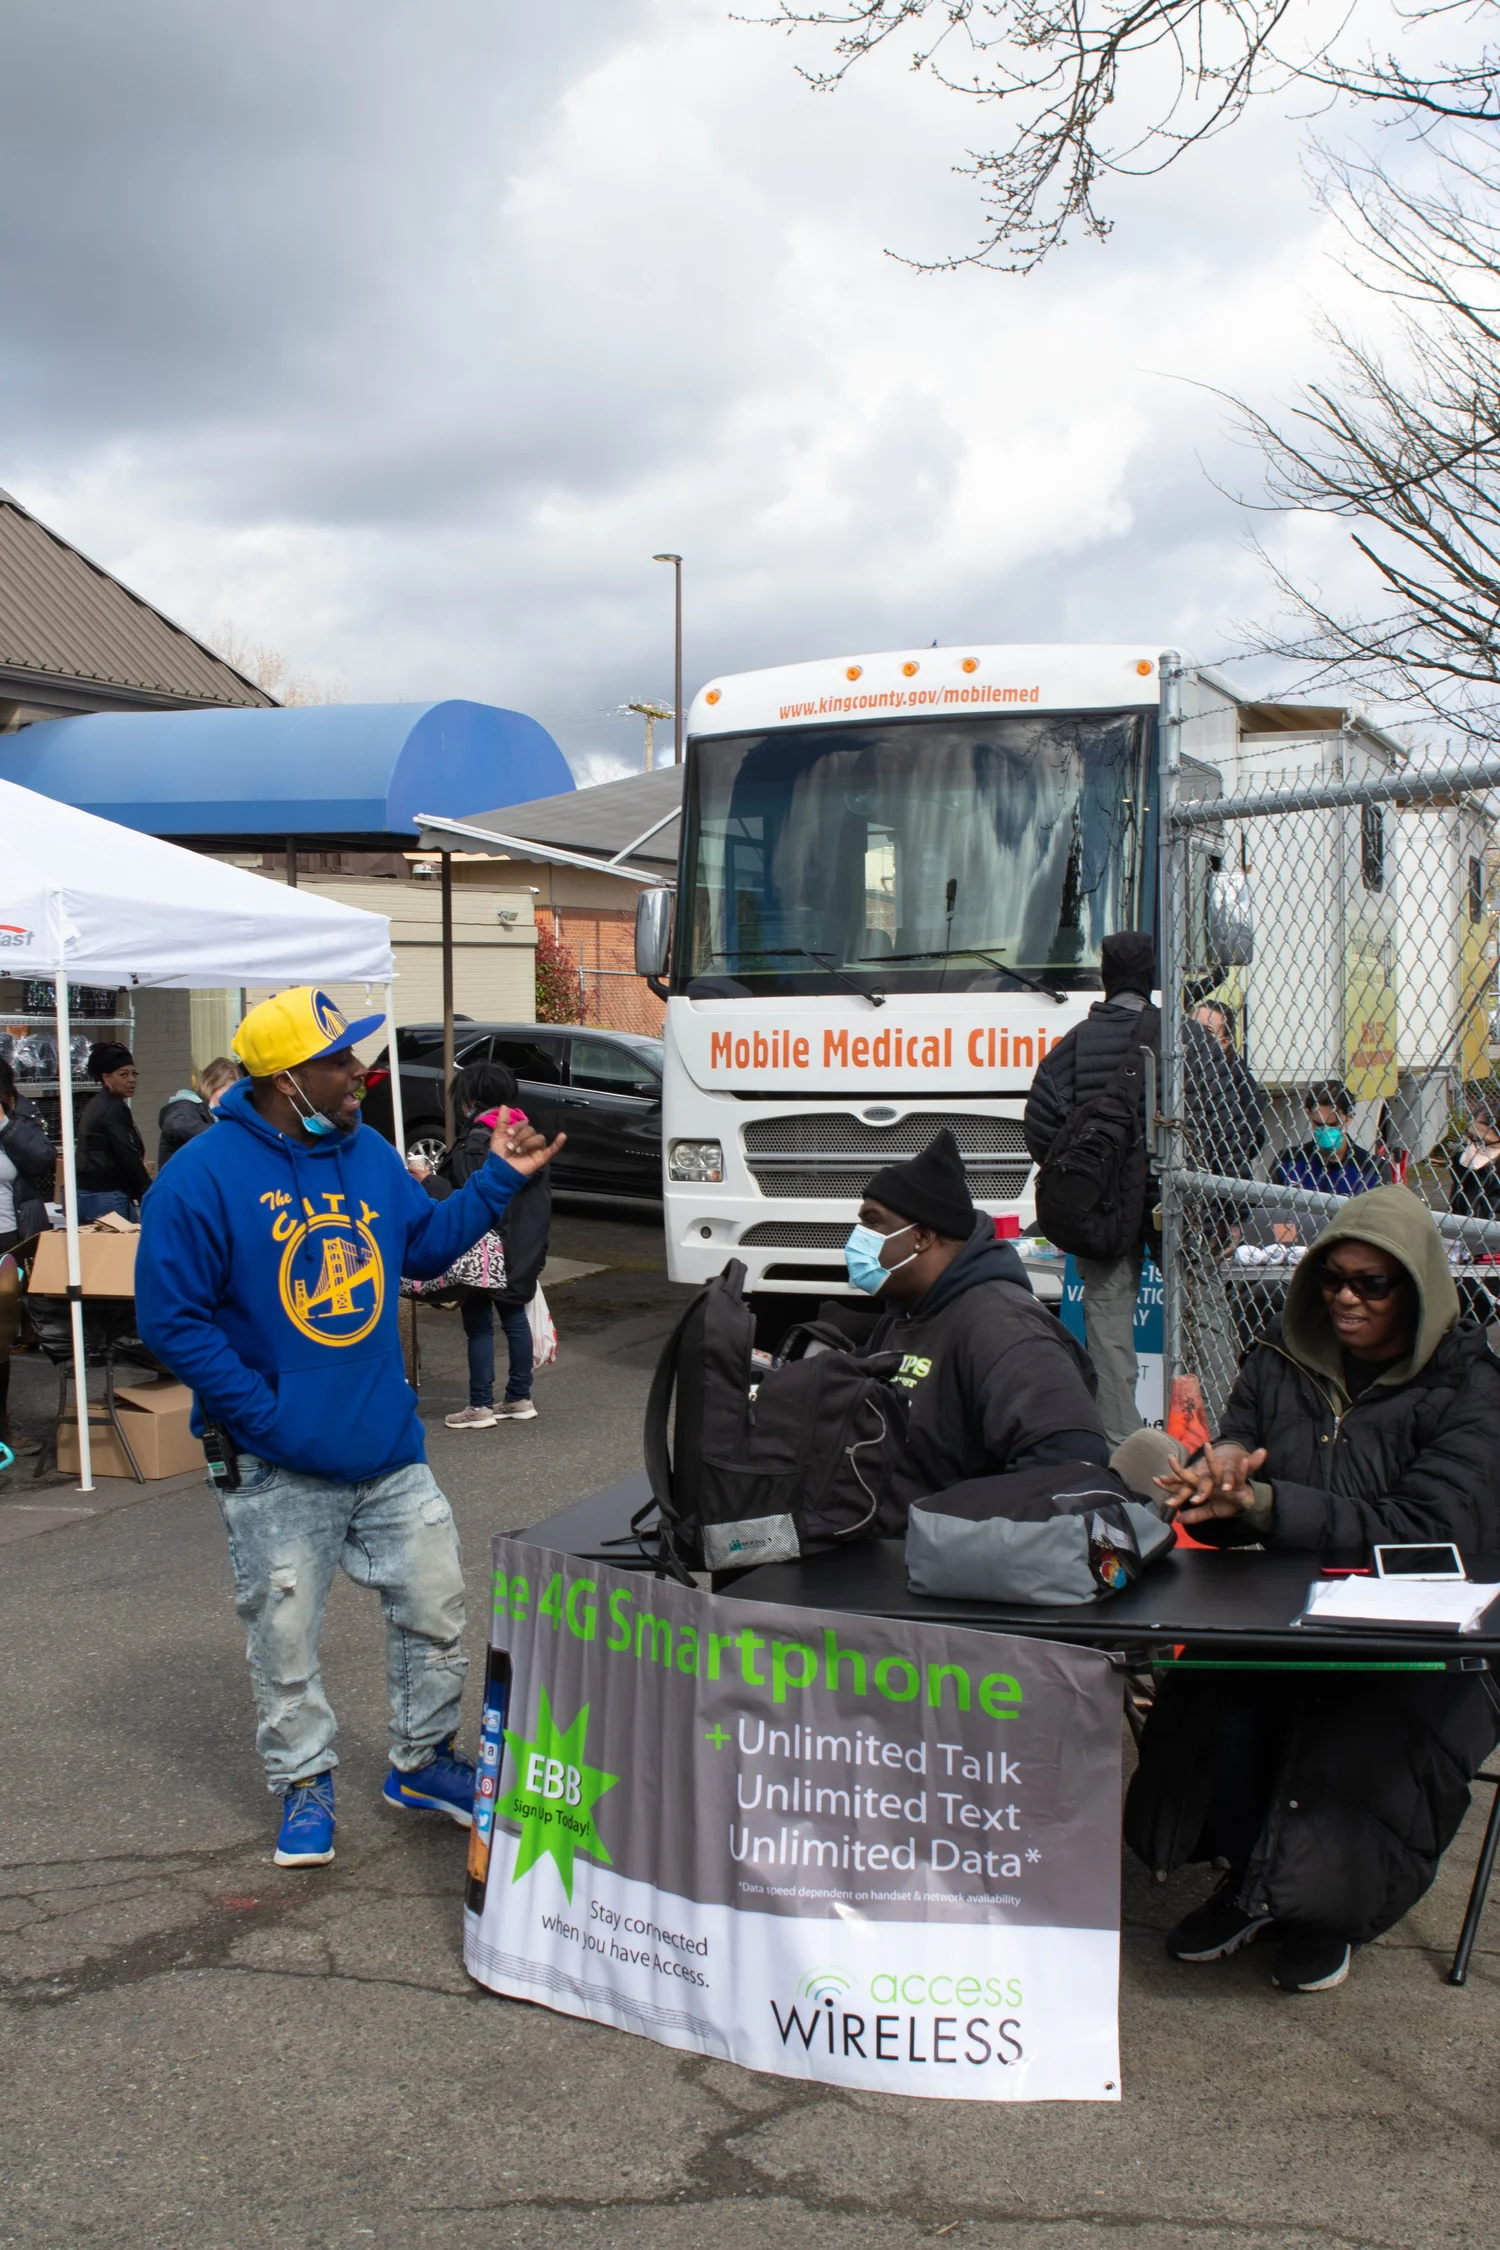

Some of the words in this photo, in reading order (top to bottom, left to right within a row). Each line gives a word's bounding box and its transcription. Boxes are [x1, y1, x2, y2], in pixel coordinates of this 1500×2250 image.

[779, 685, 1040, 720] www.kingcounty.gov/mobilemed
[0, 930, 35, 947] ast
[710, 1029, 810, 1069] Mobile
[823, 1027, 952, 1068] Medical
[259, 1189, 293, 1211] The
[271, 1192, 380, 1242] CITY
[538, 1572, 597, 1641] 4G
[606, 1587, 1024, 1720] Smartphone
[738, 1718, 927, 1775] Unlimited
[936, 1743, 1022, 1785] Talk
[525, 1752, 582, 1807] EBB
[737, 1773, 927, 1824] Unlimited
[936, 1792, 1021, 1831] Text
[555, 1809, 590, 1838] Today!
[729, 1823, 916, 1871] Unlimited
[590, 1900, 621, 1931] Stay
[766, 1886, 796, 1897] speed
[797, 1887, 853, 1900] dependent
[854, 1891, 869, 1900] on
[870, 1889, 912, 1901] handset
[913, 1890, 922, 1901] &
[923, 1892, 965, 1903] network
[966, 1893, 1021, 1908] availability
[541, 1913, 580, 1942] when
[582, 1931, 606, 1954] you
[609, 1938, 650, 1968] have
[652, 1953, 711, 1988] Access.
[869, 1973, 1023, 2008] access
